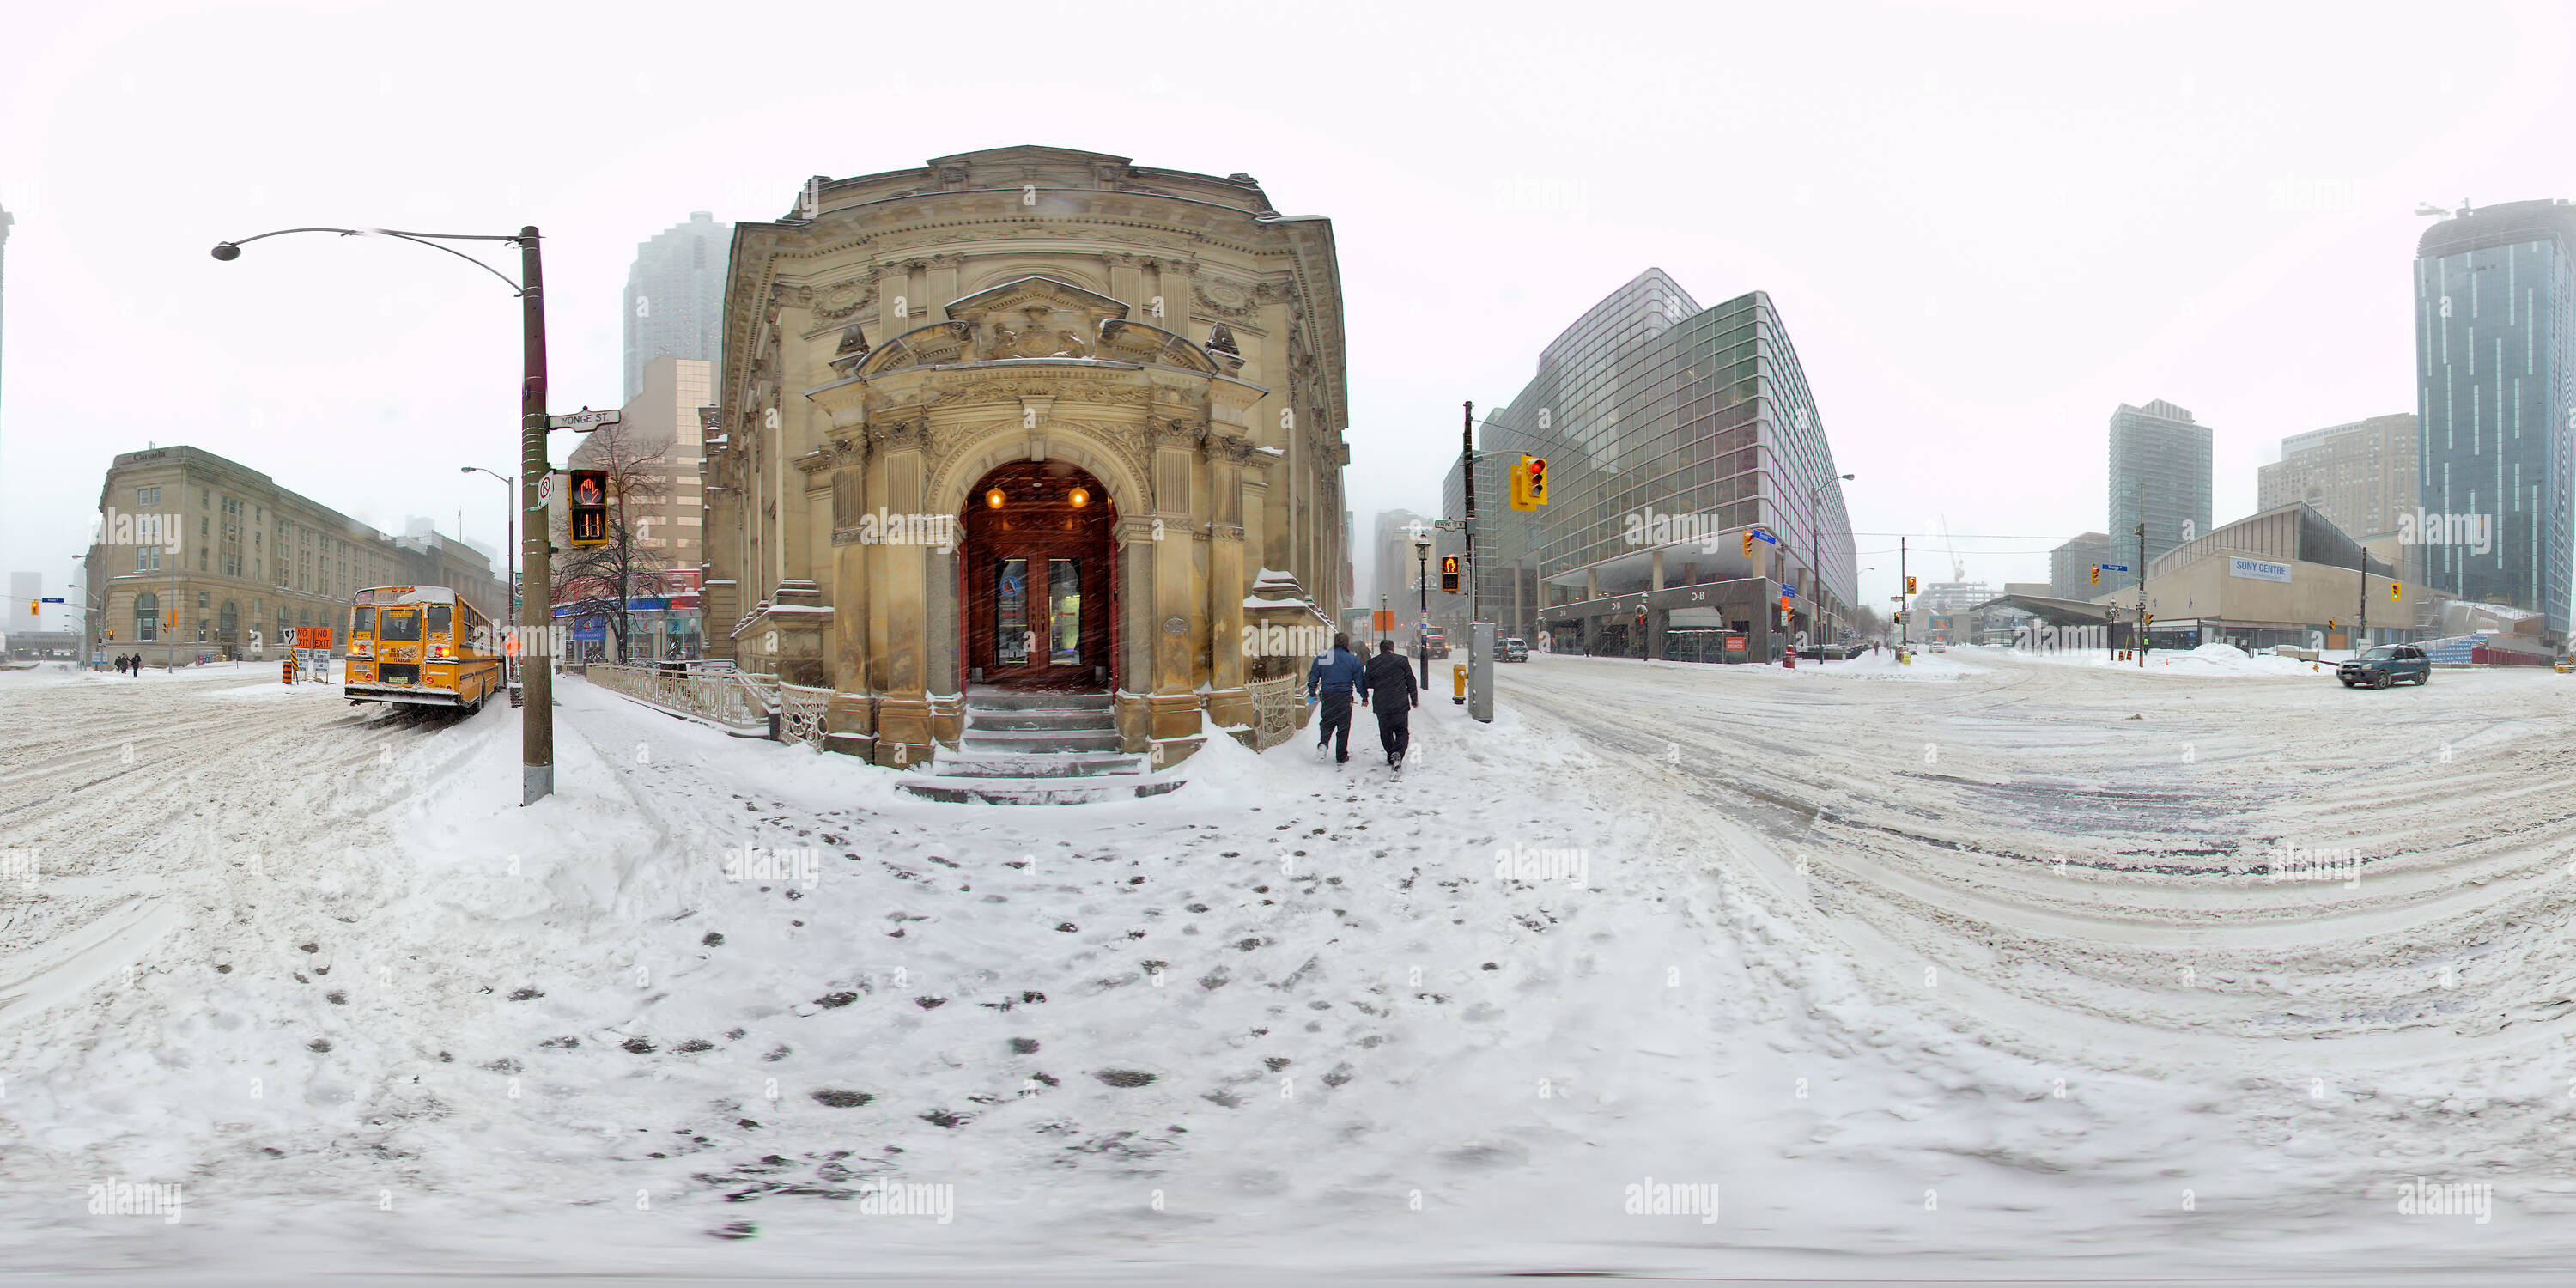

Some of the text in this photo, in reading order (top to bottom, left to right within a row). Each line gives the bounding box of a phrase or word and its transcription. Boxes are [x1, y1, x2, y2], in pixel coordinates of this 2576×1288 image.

[562, 414, 592, 425] YONGE
[133, 449, 165, 461] Canada
[2237, 561, 2286, 575] SONY CENTRE
[297, 638, 309, 647] XIT
[314, 639, 330, 647] EXIT
